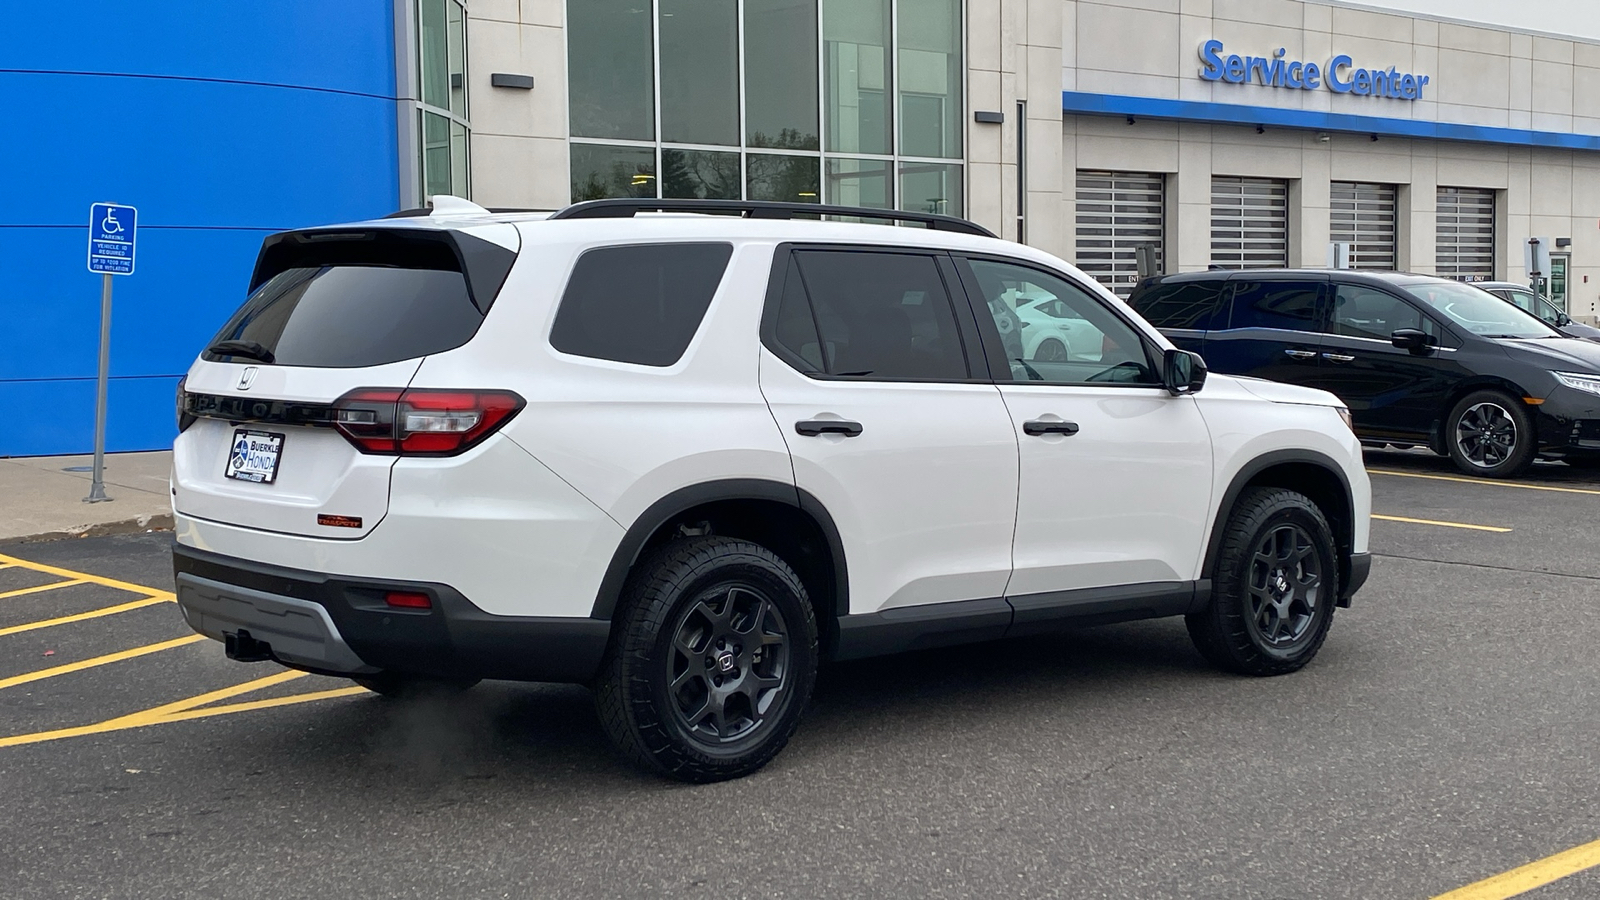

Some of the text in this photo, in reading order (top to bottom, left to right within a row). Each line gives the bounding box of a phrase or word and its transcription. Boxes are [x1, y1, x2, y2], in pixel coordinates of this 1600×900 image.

[1199, 39, 1430, 100] Service Center
[250, 440, 279, 453] BUERKLE
[246, 451, 276, 470] HONDA
